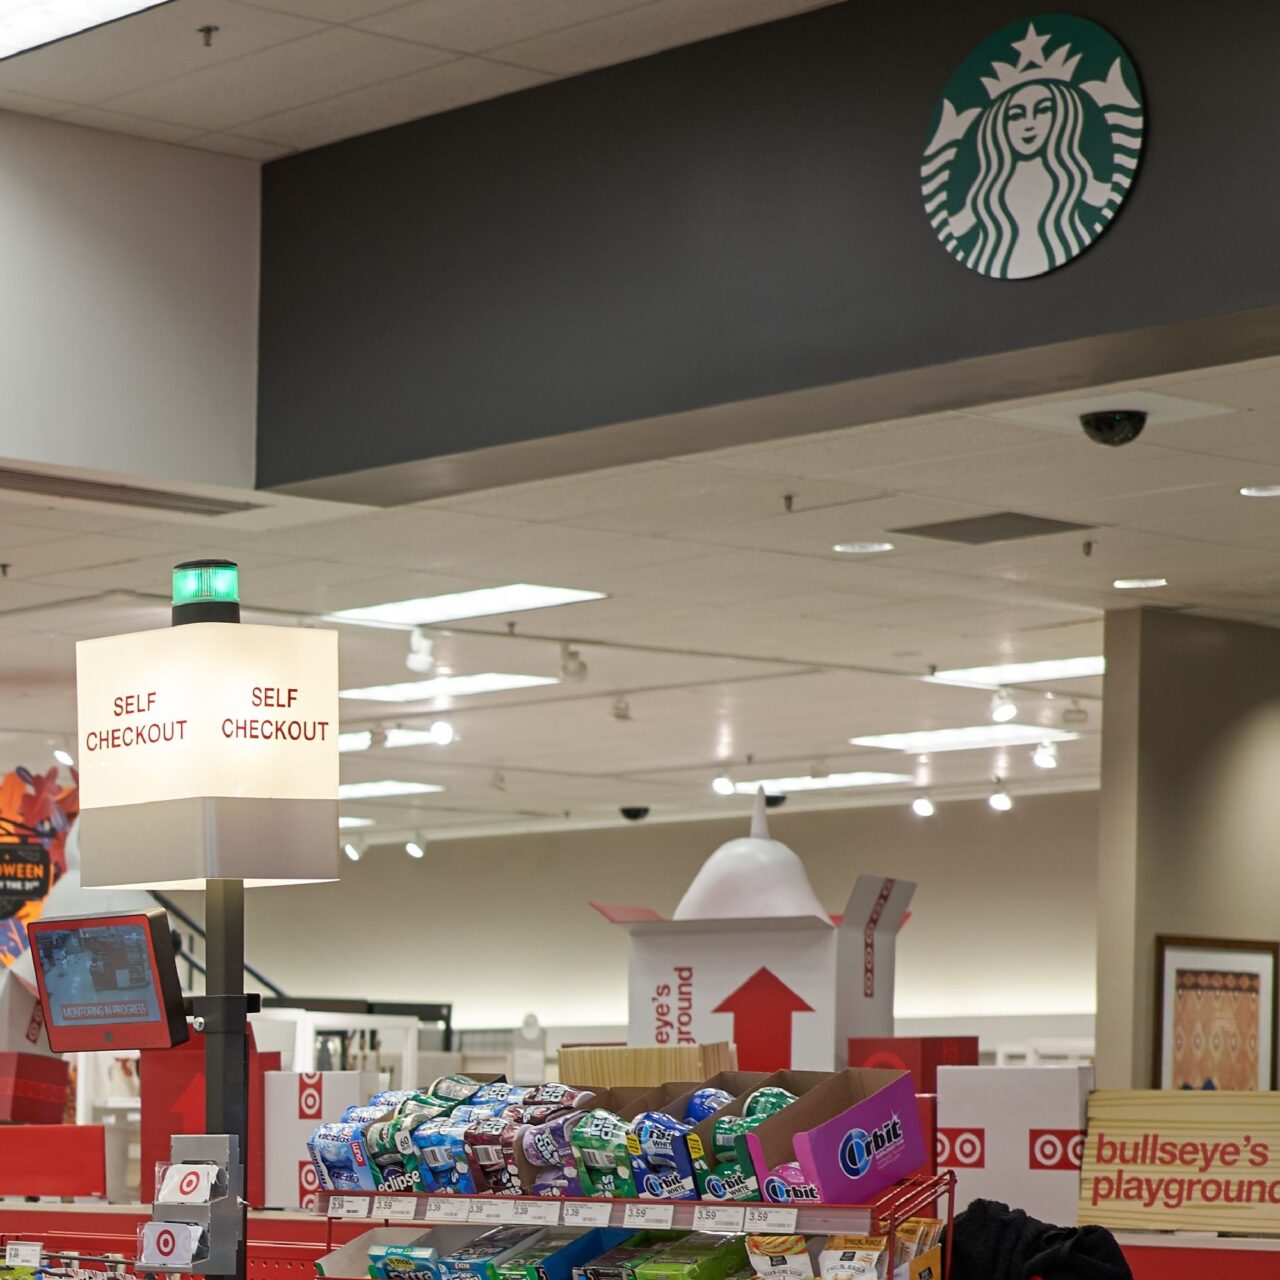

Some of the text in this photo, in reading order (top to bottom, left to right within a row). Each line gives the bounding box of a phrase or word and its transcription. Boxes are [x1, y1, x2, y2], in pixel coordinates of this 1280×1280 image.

[113, 691, 157, 717] SELF
[251, 686, 298, 708] SELF
[86, 719, 188, 752] CHECKOUT
[221, 718, 329, 742] CHECKOUT
[652, 1140, 672, 1149] WHIT
[838, 1119, 903, 1180] Orbit
[1095, 1132, 1269, 1173] bullseye's
[378, 1170, 421, 1193] eclipse
[643, 1171, 682, 1199] Orbit
[665, 1184, 686, 1196] WHITE
[705, 1171, 747, 1200] Orbit
[727, 1184, 750, 1196] WHITE
[764, 1175, 818, 1203] Orbit
[628, 1207, 647, 1218] 3.59
[697, 1210, 716, 1220] 3.59
[749, 1212, 768, 1222] 3.59
